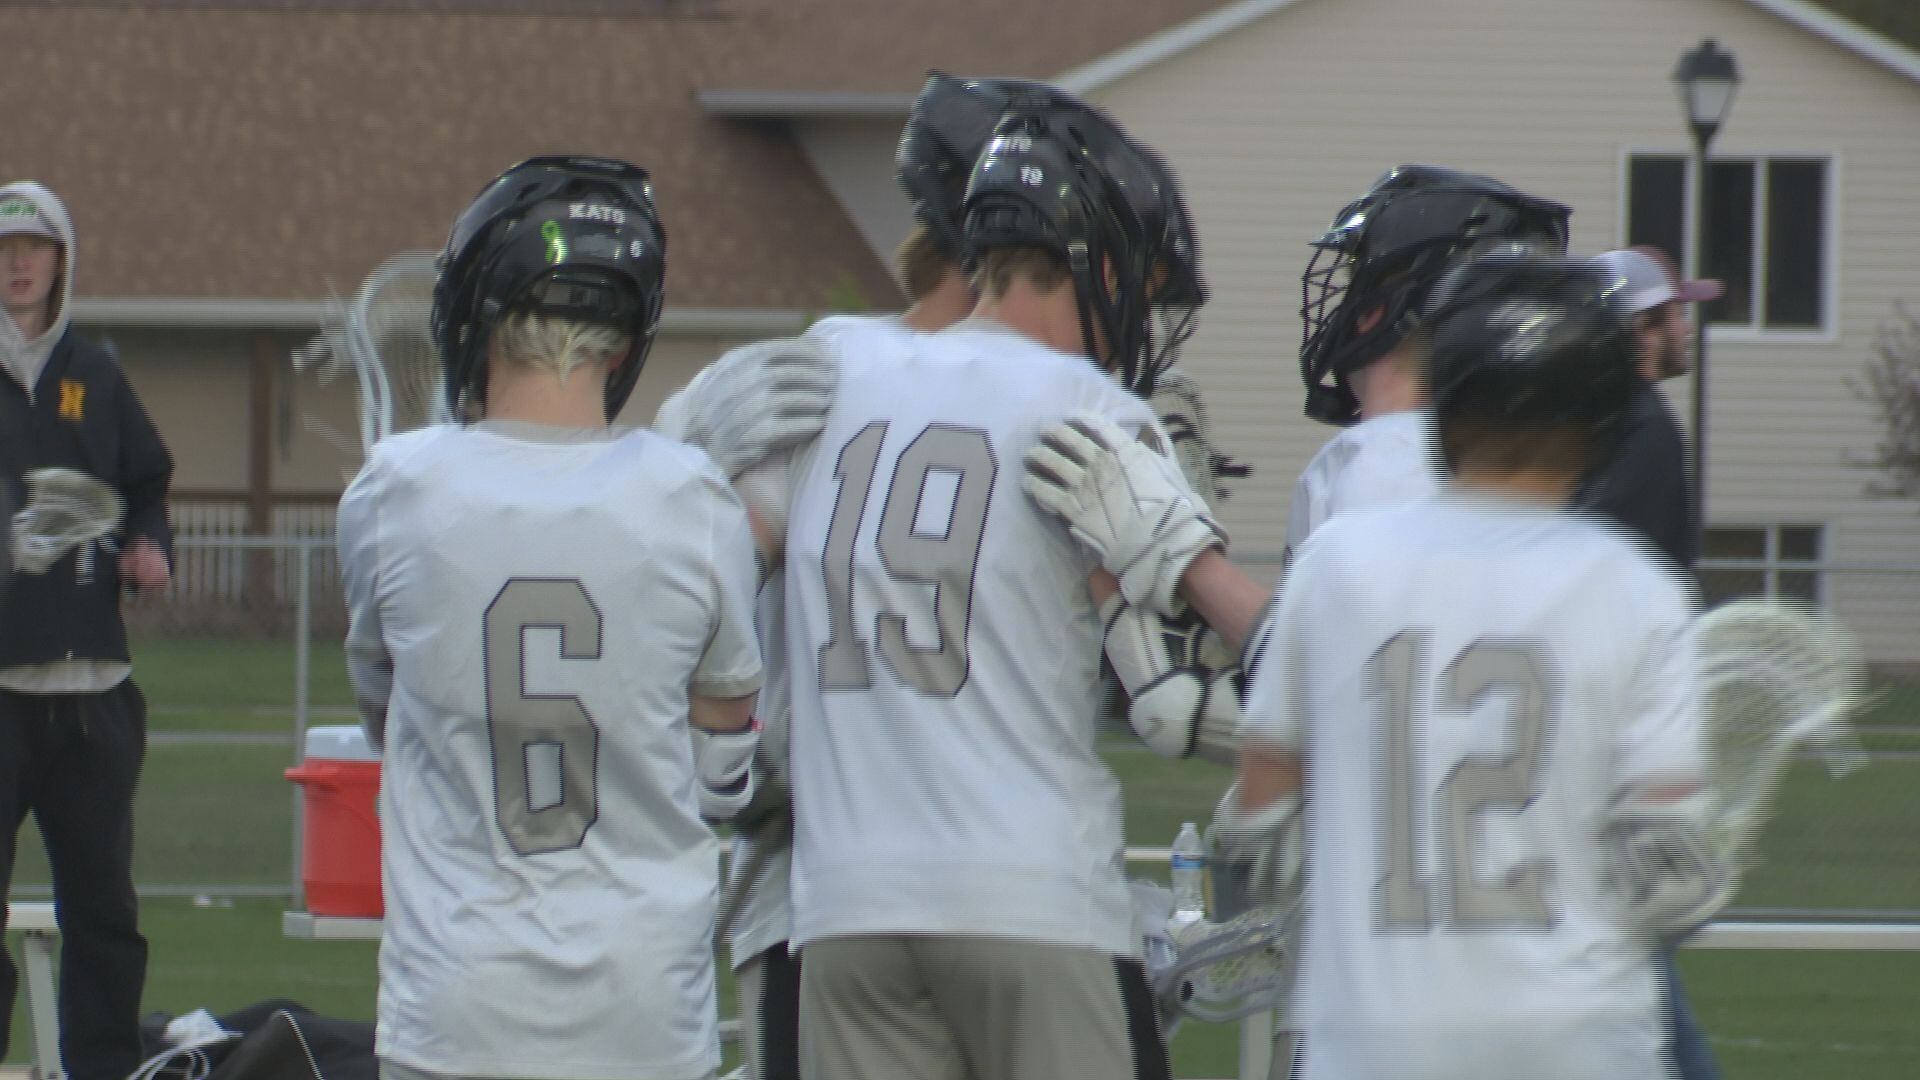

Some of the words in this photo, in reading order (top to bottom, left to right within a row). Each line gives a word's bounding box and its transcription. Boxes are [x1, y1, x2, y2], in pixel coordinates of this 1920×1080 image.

[568, 203, 626, 224] KATO
[629, 240, 642, 258] 6
[1020, 165, 1044, 188] 19
[818, 420, 999, 699] 19
[482, 577, 603, 856] 6
[1362, 627, 1563, 936] 12
